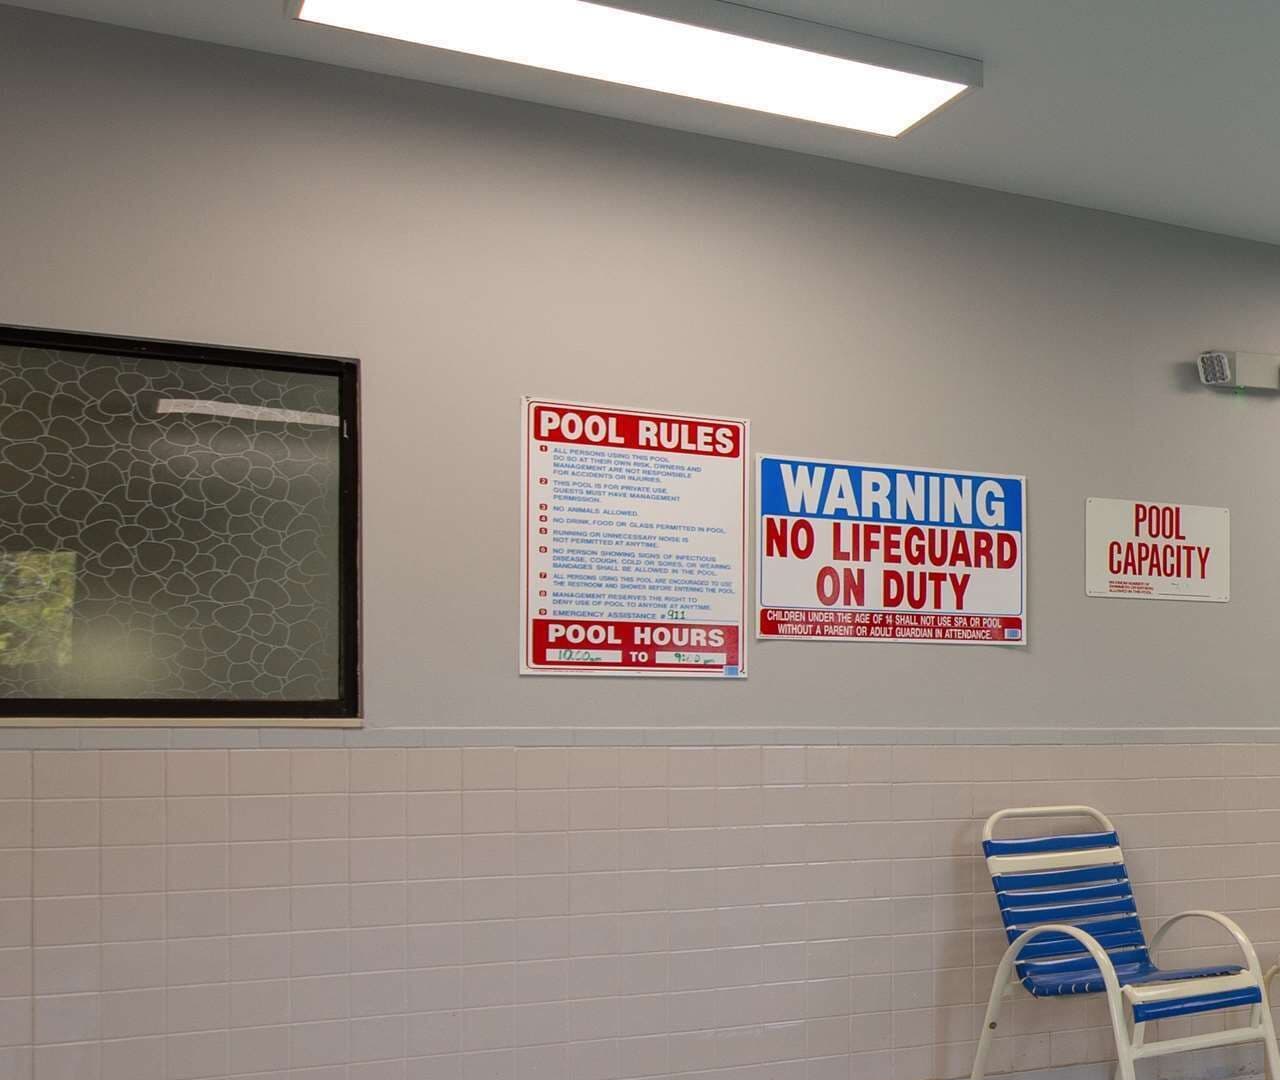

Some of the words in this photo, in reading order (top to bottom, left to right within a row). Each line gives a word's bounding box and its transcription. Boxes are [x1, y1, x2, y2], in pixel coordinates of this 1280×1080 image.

[540, 410, 624, 444] POOL
[638, 420, 734, 454] RULES
[569, 448, 605, 457] PERSONS
[552, 462, 605, 471] MANAGEMENT
[642, 469, 691, 478] RESPONSIBLE
[571, 470, 612, 479] ACCIDENTS
[629, 493, 679, 501] MANAGEMENT
[780, 464, 1004, 526] WARNING
[1135, 504, 1186, 540] POOL
[602, 532, 656, 540] UNNECESSARY
[766, 517, 814, 560] NO
[833, 522, 1017, 569] LIFEGUARD
[1109, 541, 1210, 580] CAPACITY
[816, 566, 864, 606] ON
[883, 570, 970, 610] DUTY
[767, 610, 805, 621] CHILDREN
[808, 611, 834, 622] UNDER
[837, 612, 851, 622] THE
[854, 613, 869, 623] AGE
[872, 613, 882, 623] OF
[886, 614, 892, 624] 14
[894, 614, 917, 624] SHALL
[920, 615, 935, 625] NOT
[937, 615, 951, 625] USE
[953, 616, 967, 626] SPA
[970, 616, 980, 626] OR
[982, 617, 1001, 627] POOL
[548, 624, 622, 644] POOL
[634, 626, 724, 647] HOURS
[777, 623, 812, 634] WITHOUT
[815, 624, 821, 634] A
[824, 624, 852, 635] PARENT
[856, 625, 867, 636] OR
[870, 626, 892, 636] ADULT
[895, 626, 932, 637] GUARDIAN
[935, 628, 942, 638] IN
[944, 628, 991, 639] ATTENDANCE.
[630, 652, 648, 662] TO
